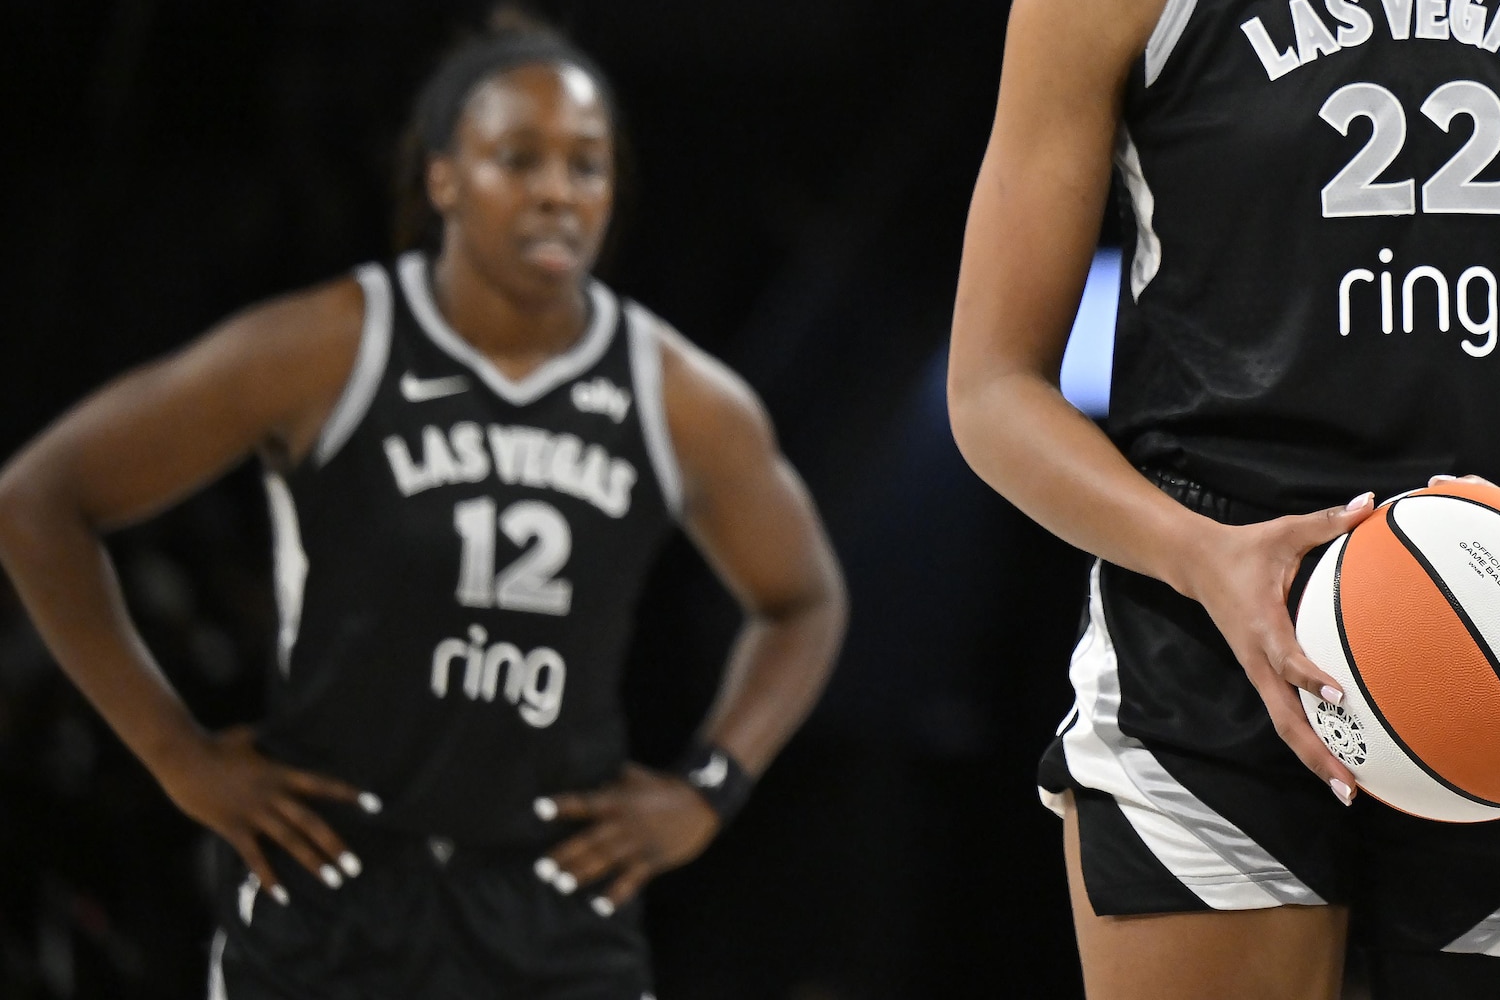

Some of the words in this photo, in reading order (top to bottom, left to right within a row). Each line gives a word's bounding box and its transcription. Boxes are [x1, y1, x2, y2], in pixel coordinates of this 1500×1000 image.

[1339, 247, 1498, 358] ring
[383, 421, 491, 498] LAS
[486, 423, 638, 519] VEGAS
[453, 496, 574, 616] 12
[1459, 541, 1487, 567] GAME
[430, 623, 567, 729] ring
